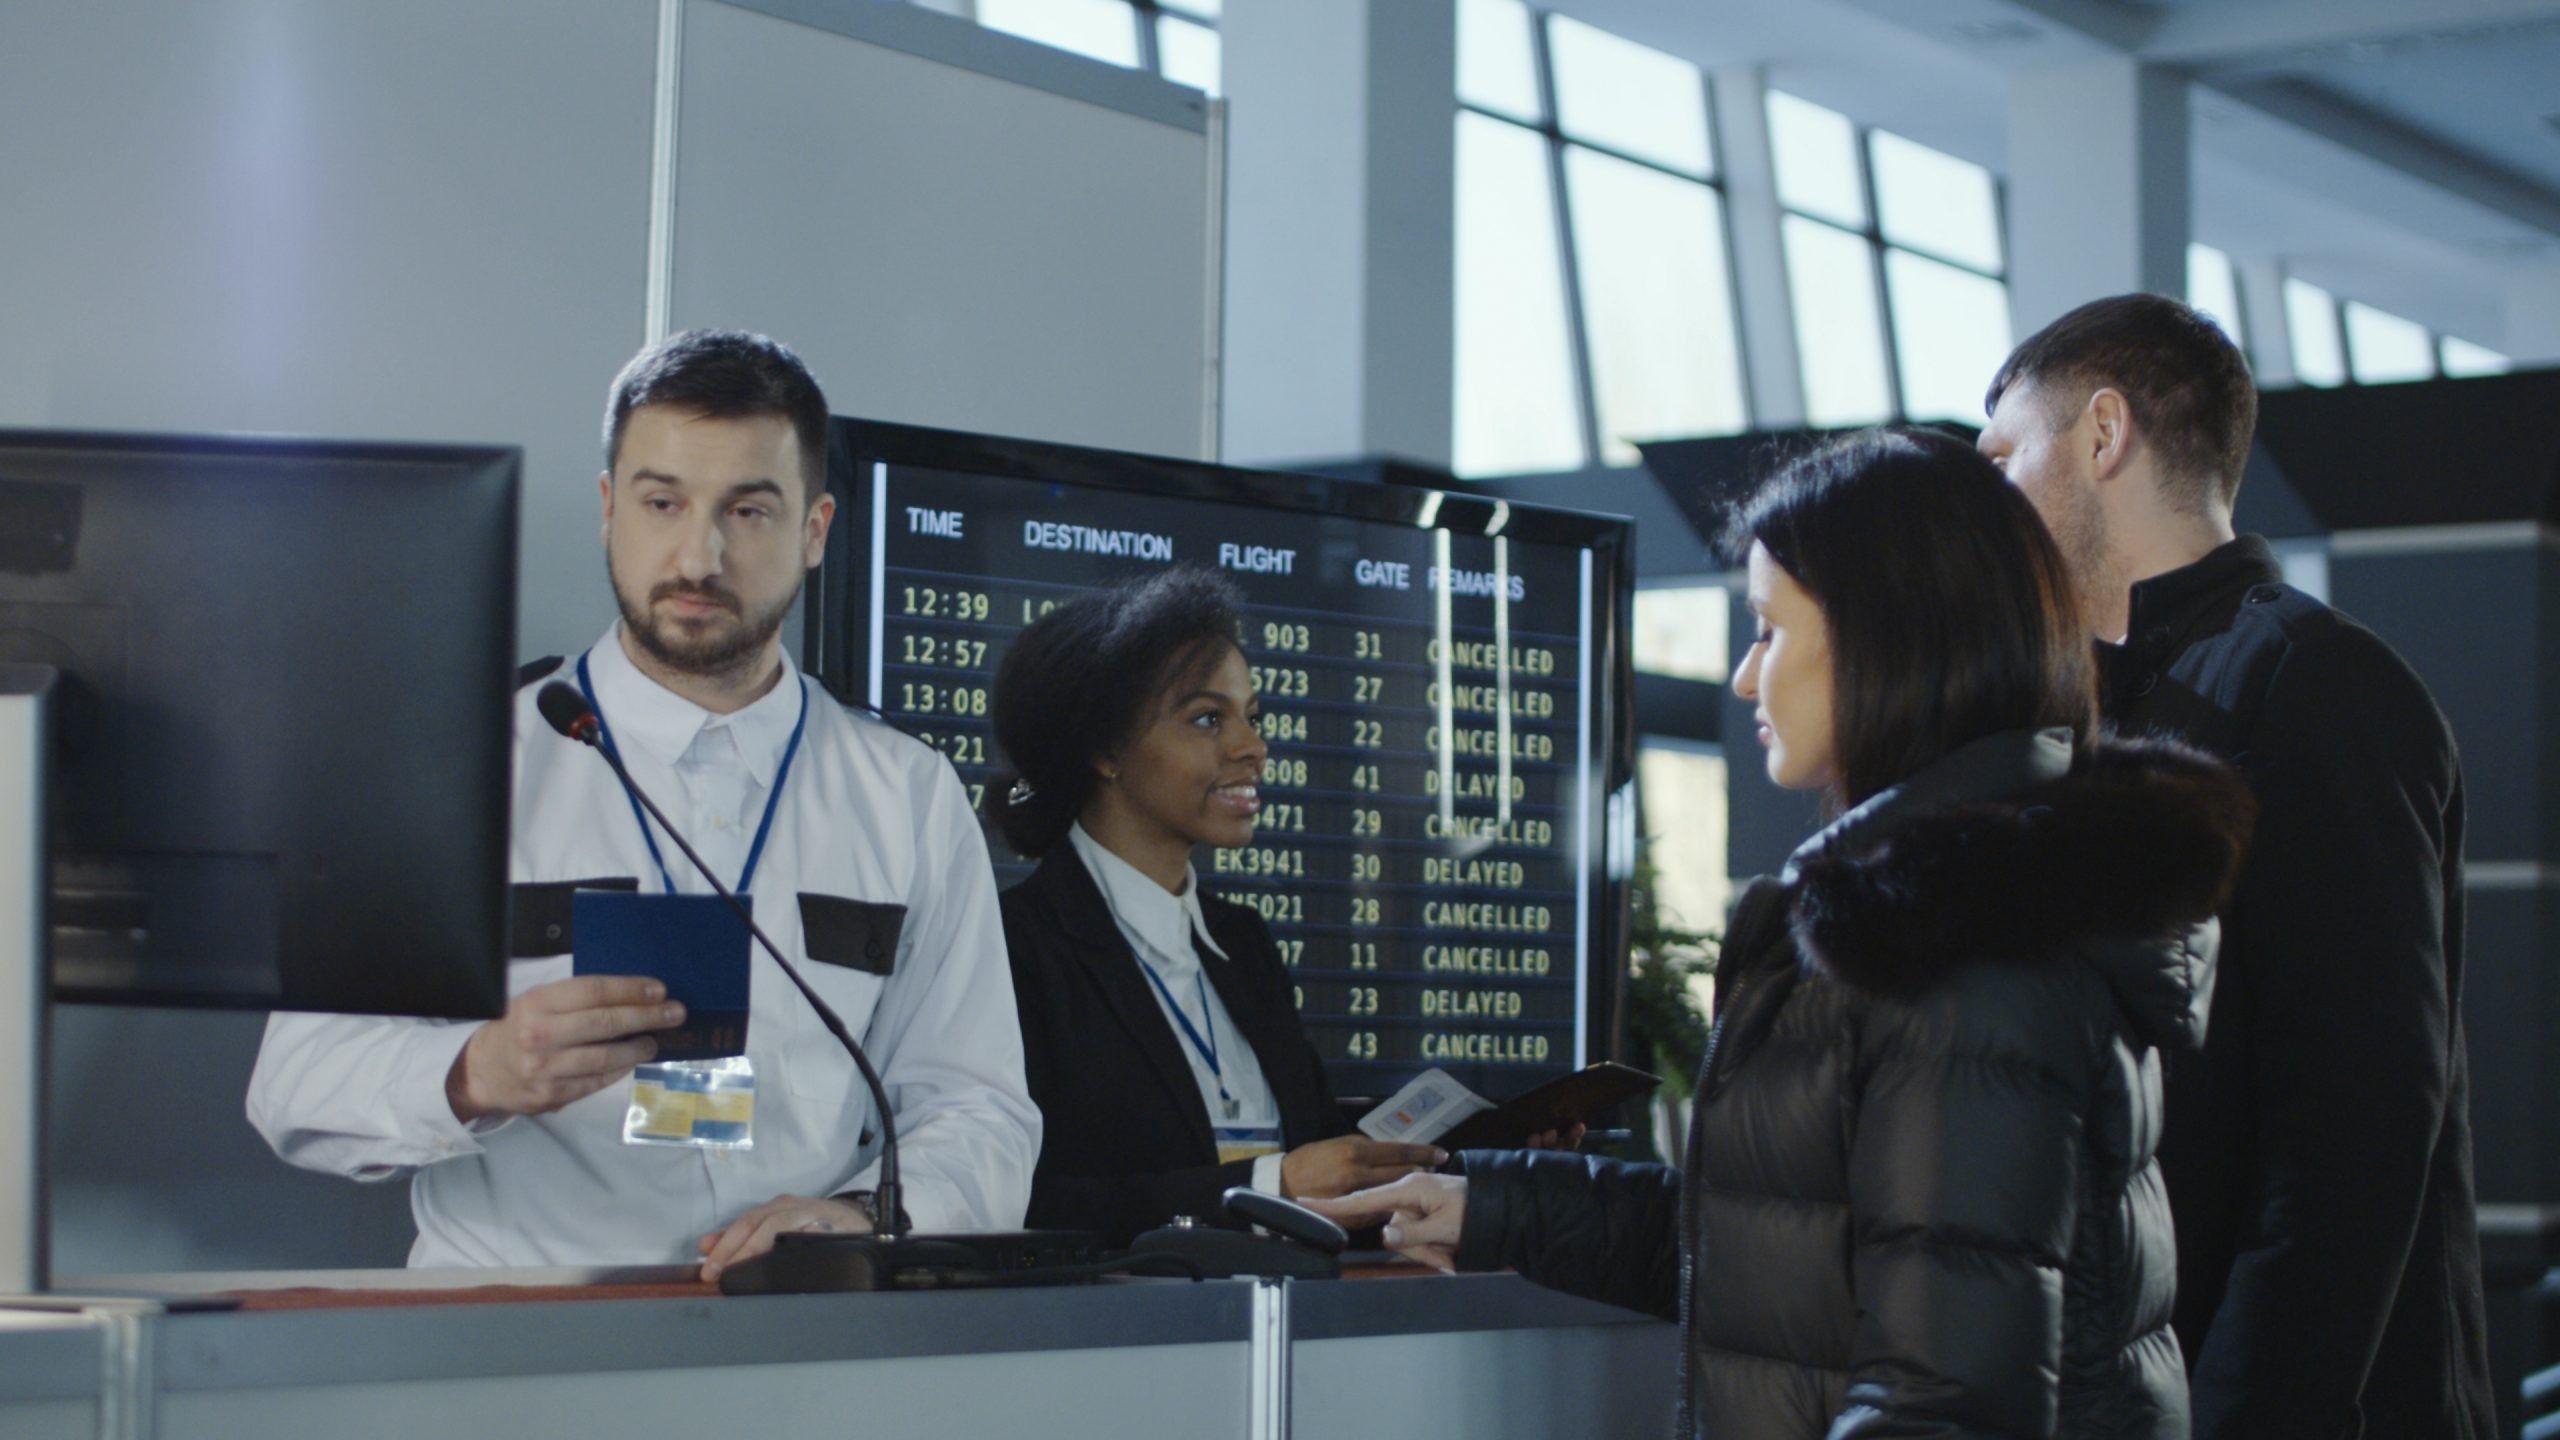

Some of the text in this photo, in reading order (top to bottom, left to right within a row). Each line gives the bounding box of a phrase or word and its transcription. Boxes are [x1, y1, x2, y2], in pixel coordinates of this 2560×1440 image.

[906, 507, 963, 537] TIME
[1024, 520, 1172, 560] DESTINATION
[1219, 543, 1296, 574] FLIGHT
[1355, 559, 1410, 590] GATE
[904, 587, 989, 621] 12:39
[1263, 621, 1310, 652] 903
[1355, 632, 1382, 660] 31
[1427, 638, 1554, 675] CNCELED
[904, 635, 1554, 719] 12:57 5723 27 CNCELED
[903, 683, 1553, 761] 13:08 984 22 CNCELED
[1262, 757, 1308, 787] 608
[1353, 767, 1380, 792] 41
[1425, 769, 1525, 801] DLAYD
[1352, 810, 1382, 837] 29
[1214, 847, 1524, 888] EK3941 30 DELAYED
[1352, 899, 1380, 925] 28
[1423, 901, 1551, 934] CANCELLED
[1351, 943, 1550, 976] 11 CANCELLED
[1350, 988, 1522, 1019] 23 DELAYED
[1349, 1033, 1549, 1062] 43 CANCELLED
